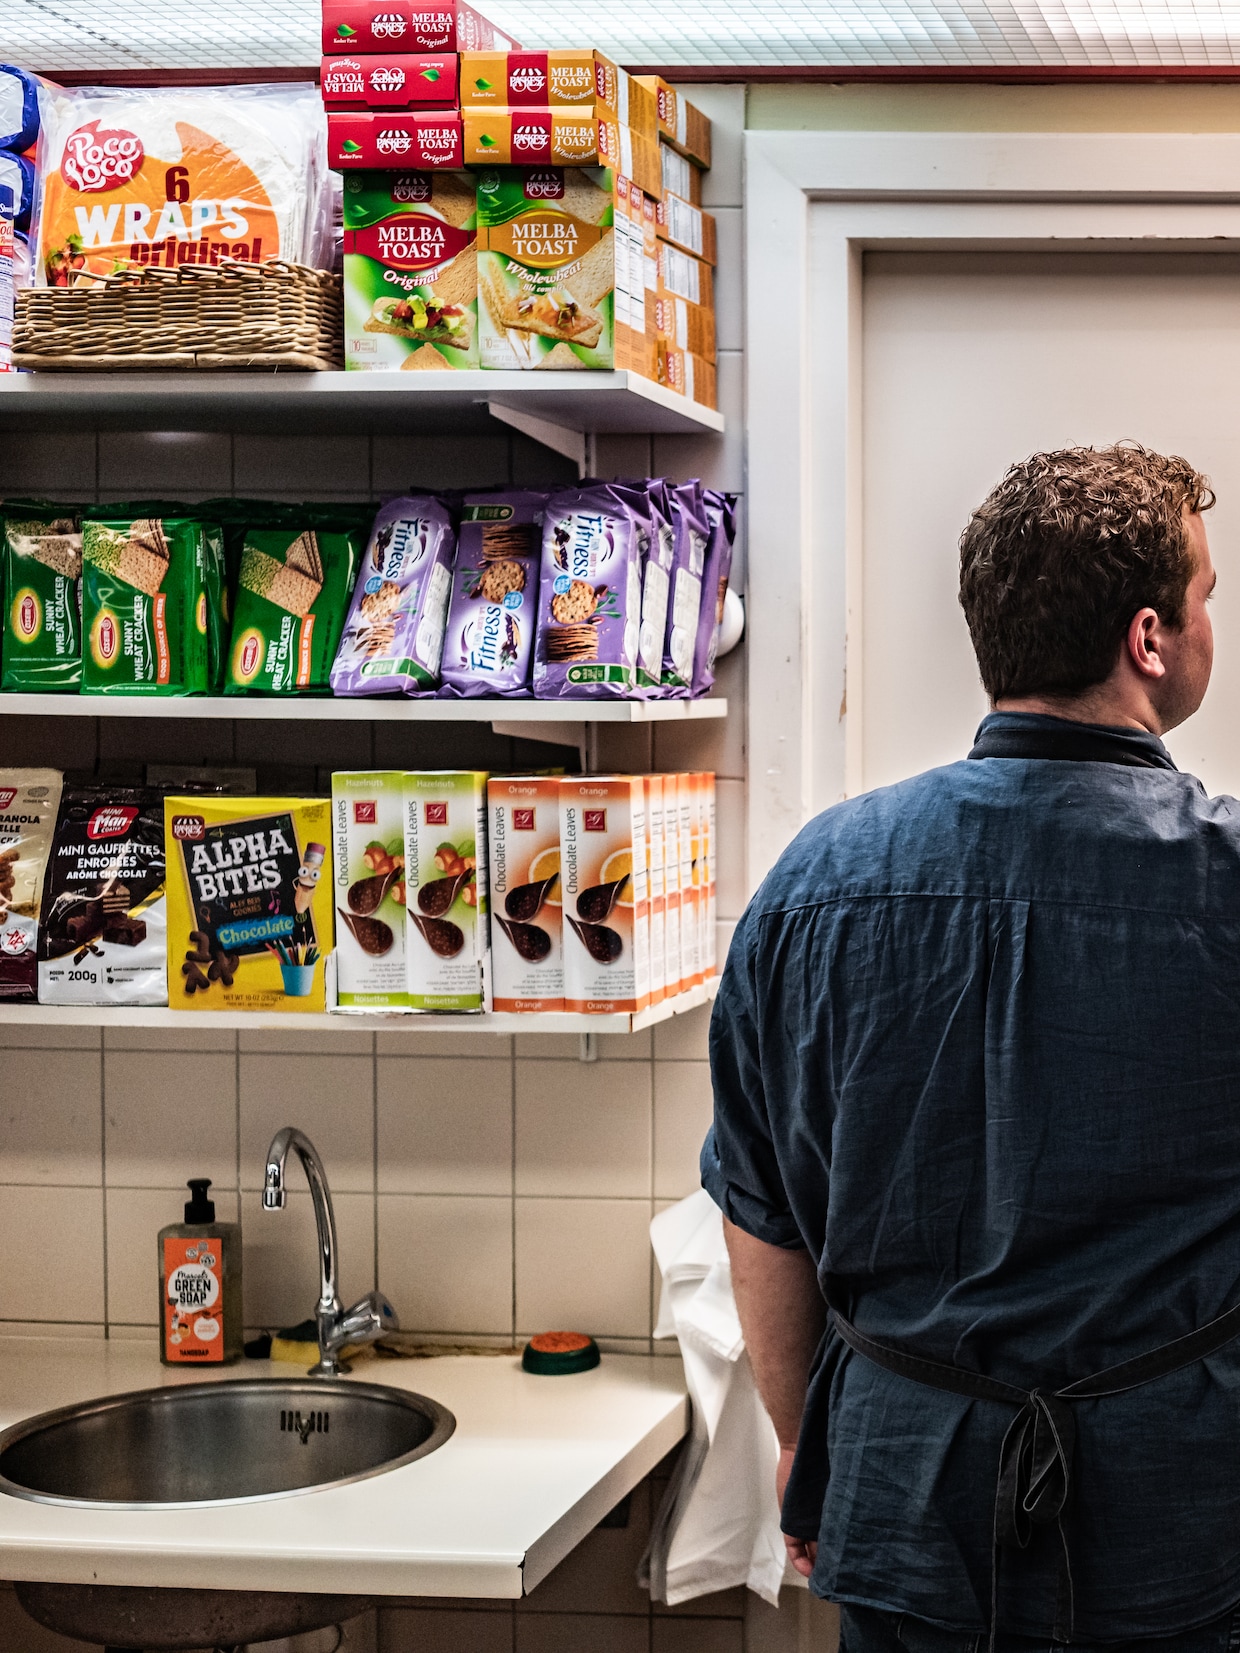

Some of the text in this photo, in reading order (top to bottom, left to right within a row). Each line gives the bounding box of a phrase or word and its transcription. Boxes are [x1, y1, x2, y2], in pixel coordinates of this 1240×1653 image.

[412, 13, 453, 22] MELBA
[412, 22, 453, 32] TOAST
[416, 35, 449, 48] Original
[330, 58, 361, 71] Original
[551, 67, 592, 76] MELBA
[324, 73, 364, 83] TOAST
[552, 76, 591, 87] TOAST
[324, 82, 364, 93] MELBA
[550, 85, 595, 101] Wholewheat
[417, 129, 458, 138] MELBA
[554, 126, 595, 136] MELBA
[68, 132, 140, 167] Poco
[417, 138, 458, 149] TOAST
[555, 136, 595, 147] TOAST
[421, 151, 454, 165] Original
[552, 145, 597, 160] Wholewheat
[65, 155, 134, 191] Loco
[165, 166, 190, 202] 6
[74, 199, 250, 247] WRAPS
[511, 223, 579, 239] MELBA
[378, 226, 446, 242] MELBA
[129, 236, 262, 268] original
[378, 242, 445, 259] TOAST
[512, 239, 578, 255] TOAST
[383, 268, 439, 291] Original
[505, 260, 583, 285] Wholewheat
[386, 518, 419, 579] Fitness
[573, 515, 602, 577] Fitness
[46, 599, 54, 631] SUNNY
[55, 576, 64, 655] WHEAT CRACKER
[124, 620, 134, 656] SUNNY
[134, 594, 144, 681] WHEAT CRACKER
[280, 616, 292, 660] CRACKER
[471, 606, 500, 672] Fitness
[265, 640, 279, 673] SUNNY
[346, 778, 384, 787] Hazelnuts
[417, 779, 455, 788] Hazelnuts
[508, 785, 538, 795] Orange
[579, 787, 608, 796] Orange
[0, 815, 40, 824] RANOLA
[93, 815, 128, 834] Man
[58, 843, 160, 856] MINI GAUFRETTES
[190, 829, 293, 874] ALPHA
[337, 800, 348, 887] Chocolate Leaves
[408, 801, 419, 888] Chocolate Leaves
[495, 806, 506, 893] Chocolate Leaves
[566, 808, 578, 894] Chocolate Leaves
[66, 869, 147, 880] ARÔME CHOCOLAT
[196, 859, 282, 902] BITES
[219, 918, 294, 944] Chocolate
[68, 971, 97, 983] 200g
[354, 995, 389, 1003] Noisettes
[424, 997, 459, 1005] Noisettes
[515, 1000, 542, 1009] Orange
[587, 1001, 614, 1009] Orange
[175, 1279, 211, 1292] GREEN
[179, 1292, 207, 1303] SOAP
